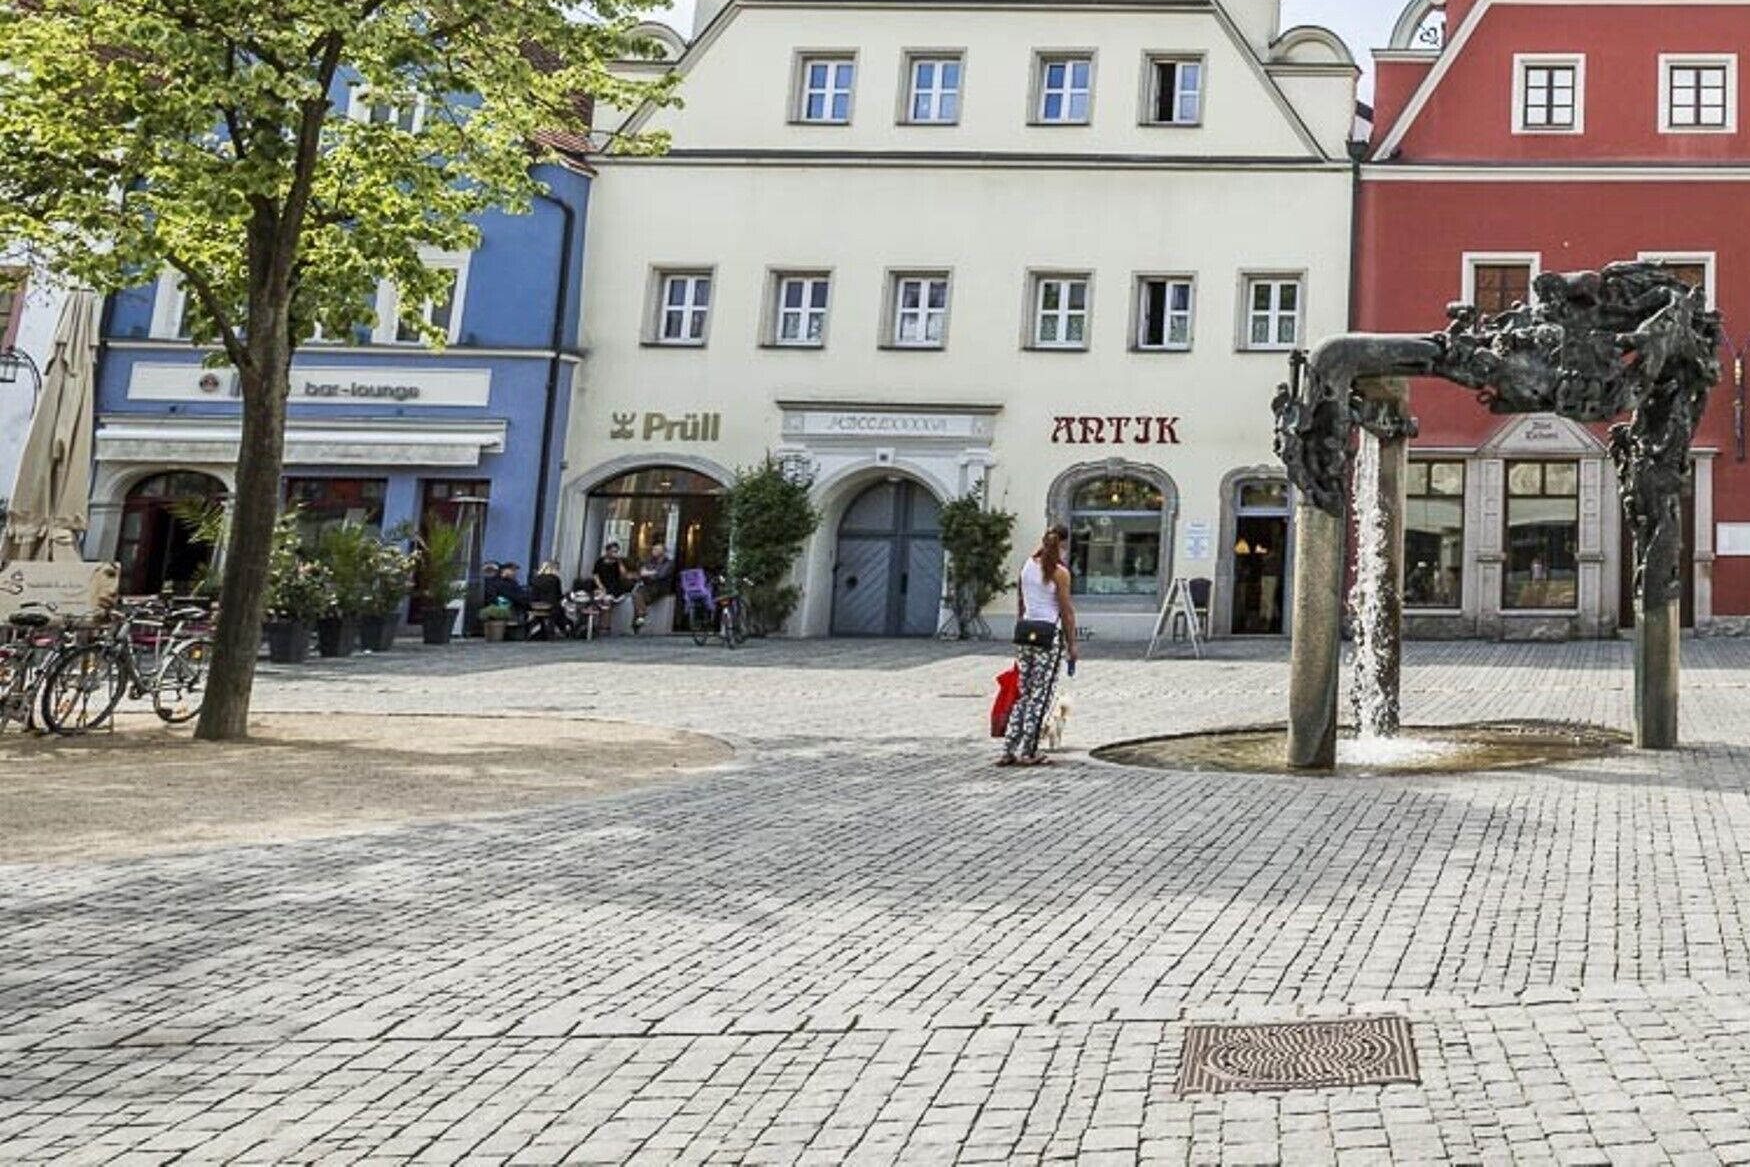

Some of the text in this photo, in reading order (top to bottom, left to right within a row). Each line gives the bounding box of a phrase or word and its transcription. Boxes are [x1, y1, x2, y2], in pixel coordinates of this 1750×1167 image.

[304, 381, 420, 401] bar-lounge
[643, 412, 721, 441] Prüll
[1051, 416, 1182, 444] ANTIK
